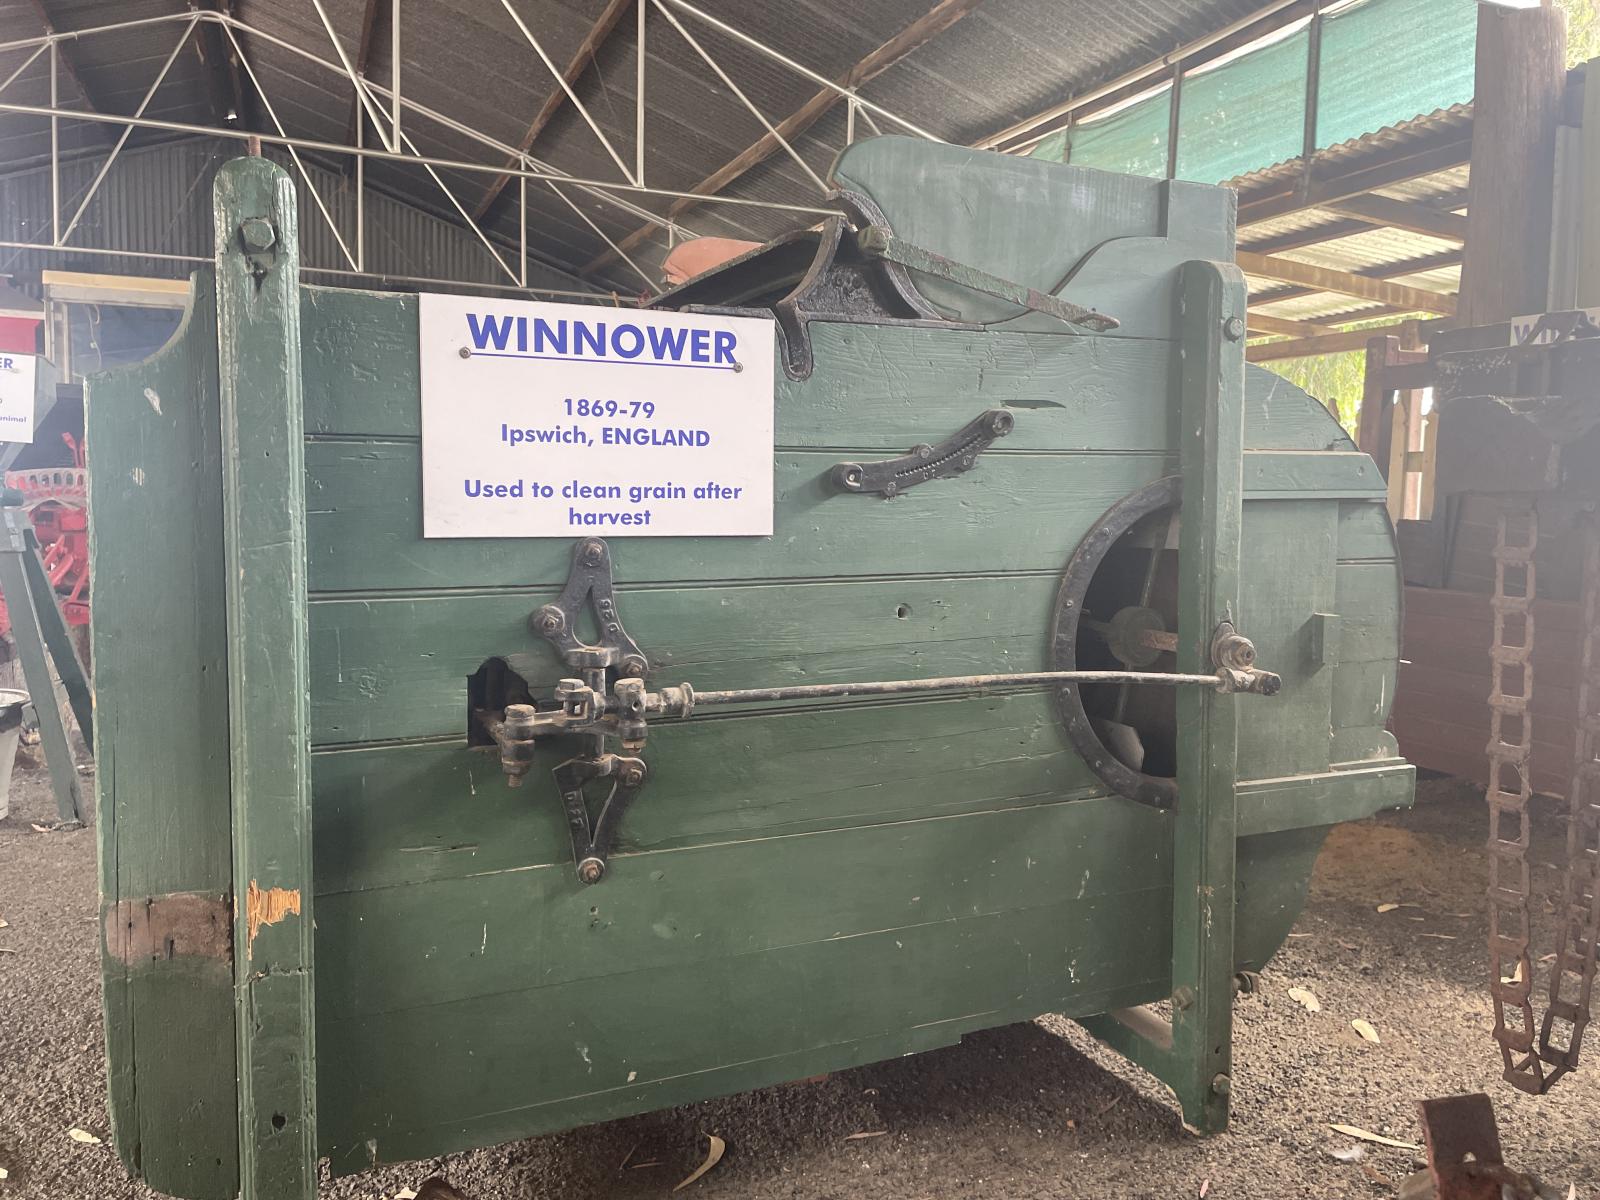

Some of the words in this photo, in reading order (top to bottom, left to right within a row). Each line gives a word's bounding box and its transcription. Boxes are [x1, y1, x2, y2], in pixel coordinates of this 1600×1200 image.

[466, 313, 737, 364] WINNOWER
[564, 399, 655, 418] 1869-79
[501, 424, 594, 447] Ipswich,
[602, 428, 710, 447] ENGLAND
[464, 480, 523, 498] Used
[532, 482, 554, 498] to
[562, 480, 621, 499] clean
[629, 481, 686, 503] grain
[693, 482, 742, 499] after
[569, 507, 651, 525] harvest
